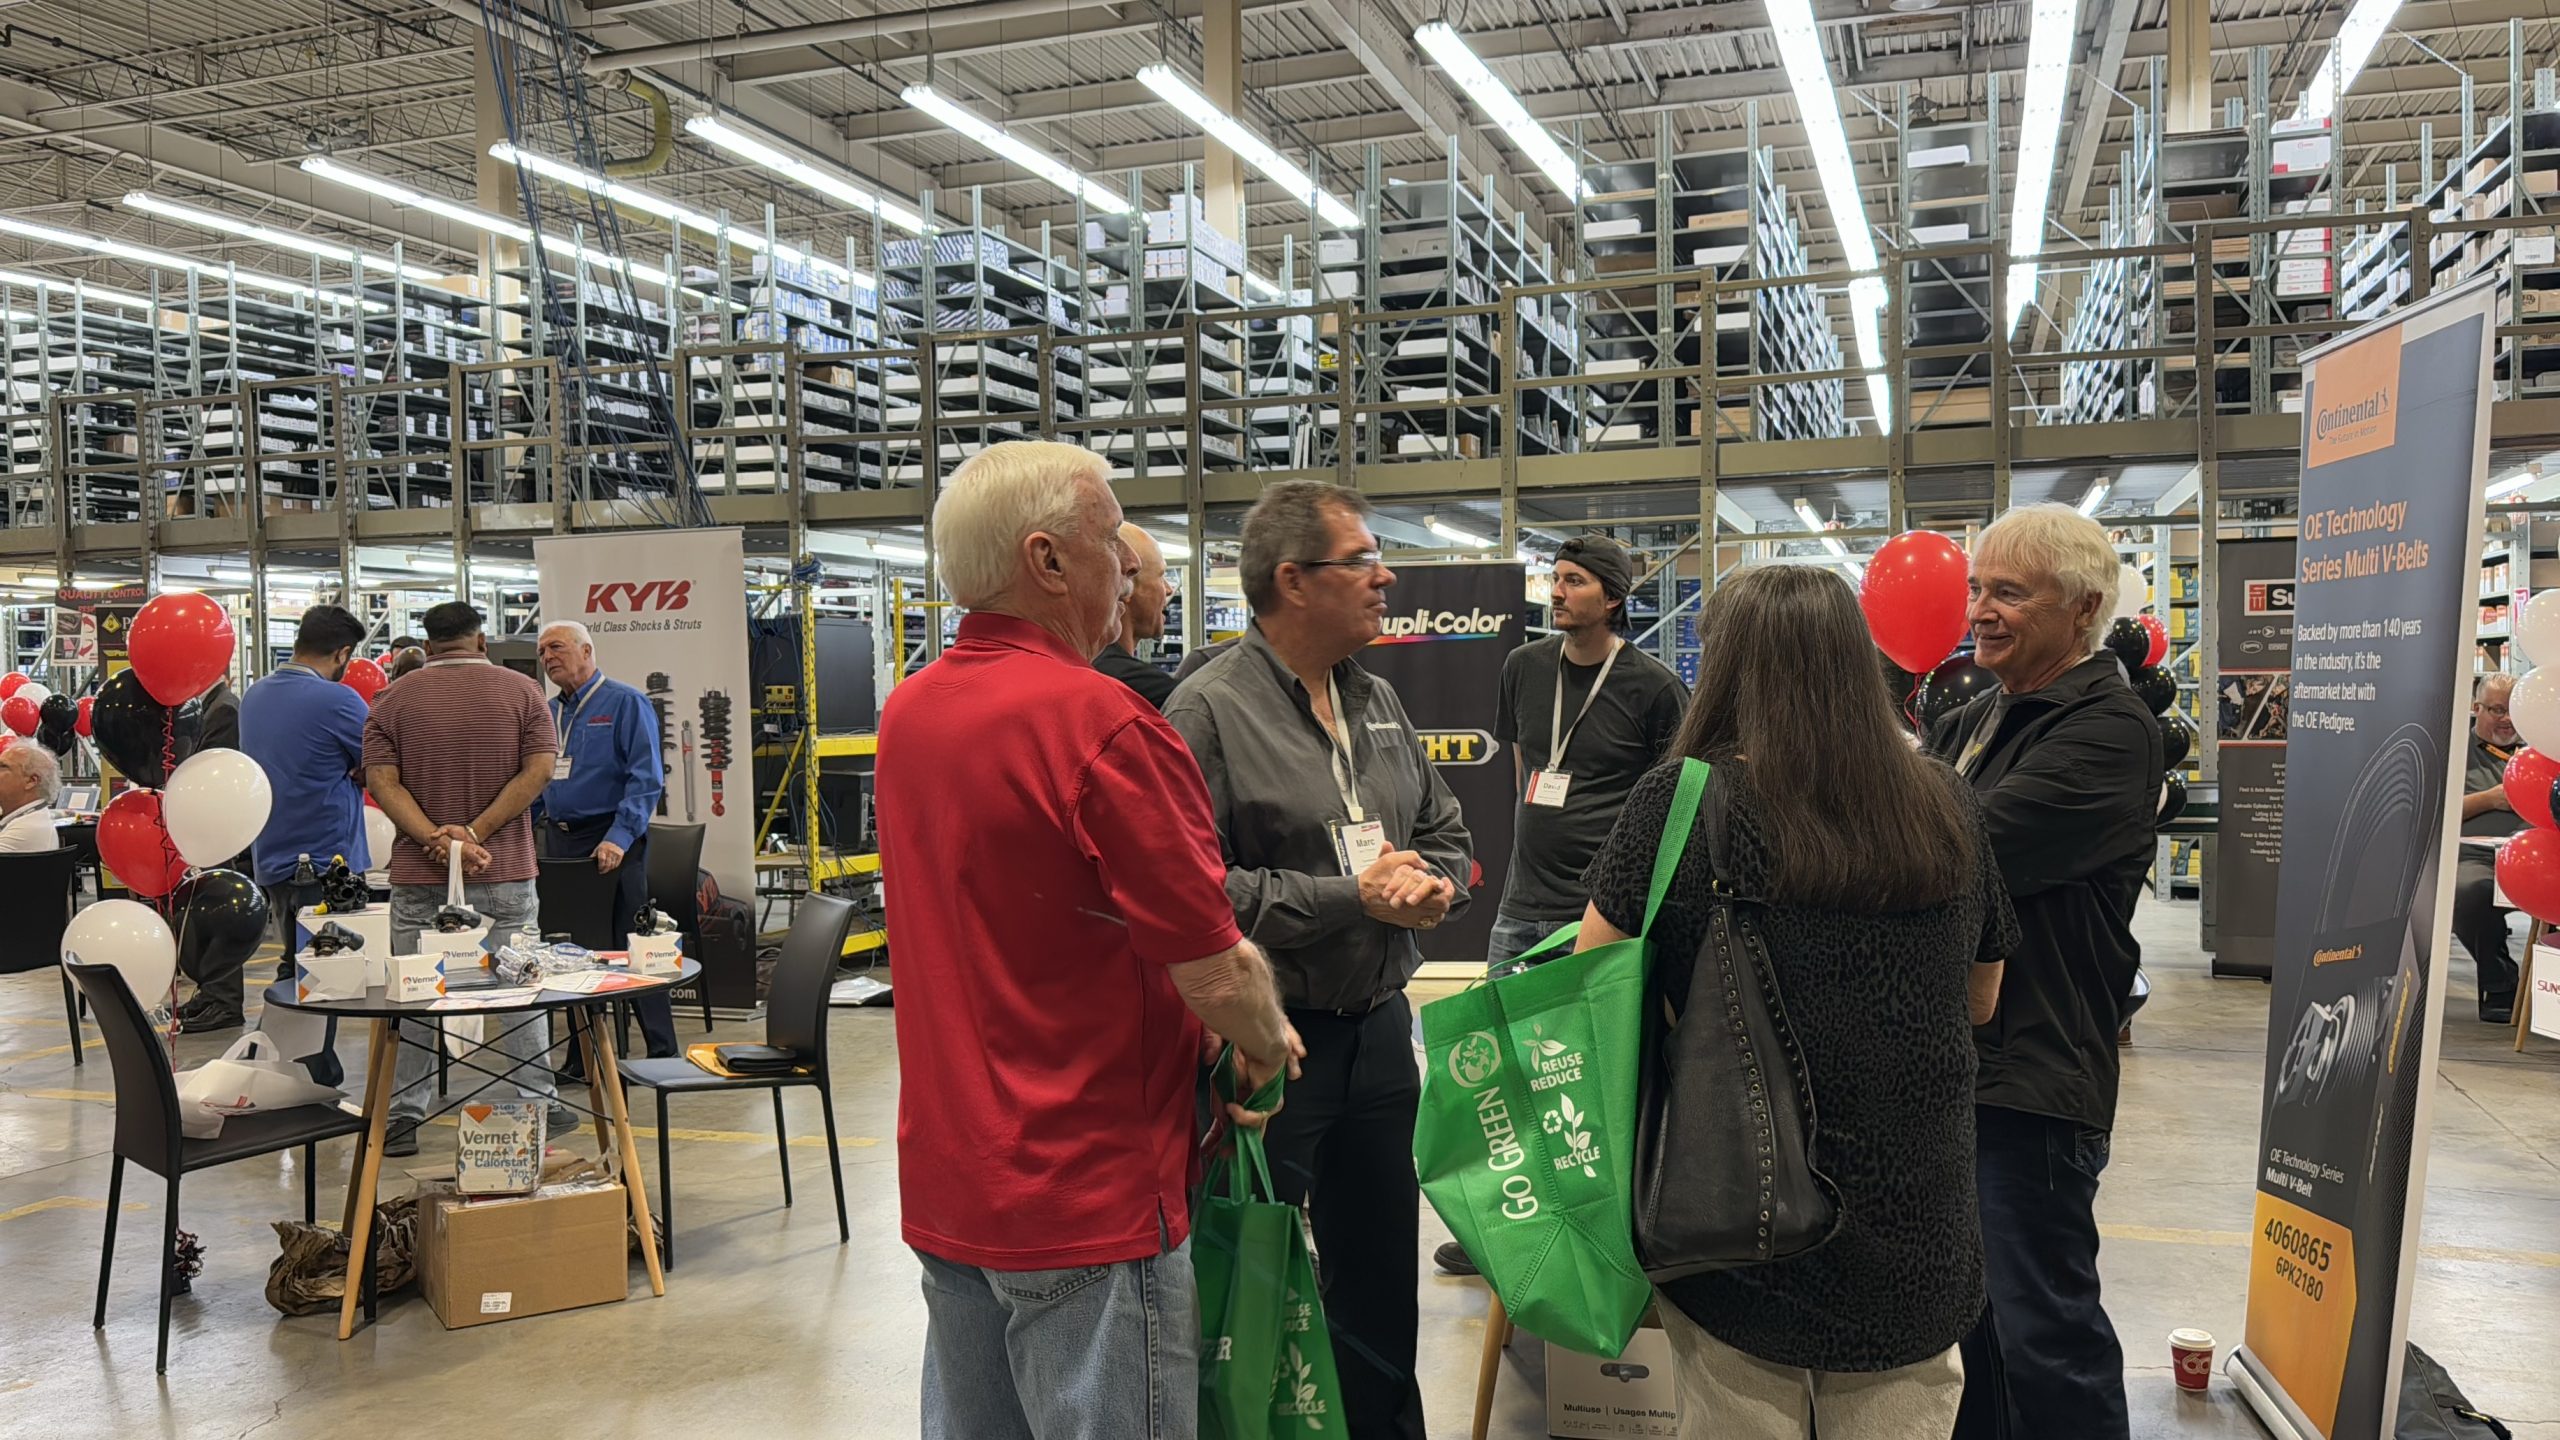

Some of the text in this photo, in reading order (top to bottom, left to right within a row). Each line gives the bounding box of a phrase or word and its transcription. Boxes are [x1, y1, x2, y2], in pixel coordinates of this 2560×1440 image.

[2316, 391, 2379, 440] Continental
[2304, 500, 2407, 540] OE Technology
[2301, 539, 2429, 584] Series Multi V-Belts
[58, 588, 146, 600] QUALITY CONTROL
[585, 580, 692, 613] KYB
[585, 618, 702, 633] orld Class Shocks & Struts
[2297, 617, 2422, 644] Backed by more than 140 years
[2295, 651, 2381, 674] in the industry, it's the
[2293, 681, 2376, 701] aftermarket belt with
[2292, 711, 2355, 734] the OE Pedigree.
[1418, 735, 1478, 760] HT
[1356, 838, 1375, 848] Marc
[451, 950, 478, 959] Vernet
[654, 950, 677, 959] Vernet
[2313, 945, 2356, 967] Continental
[412, 975, 438, 984] Vernet
[1541, 1051, 1584, 1074] REUSE
[1530, 1067, 1583, 1092] REDUCE
[463, 1130, 518, 1145] Vernet
[474, 1157, 528, 1168] Calorstat
[1473, 1086, 1539, 1220] GO GREEN
[1553, 1146, 1601, 1171] RECYCLE
[2270, 1148, 2345, 1184] OE Technology Series
[2265, 1166, 2313, 1198] Multi V-Belt
[2264, 1217, 2333, 1272] 4060865
[2275, 1256, 2324, 1302] 6PK2180
[1563, 1403, 1601, 1413] Multiuse
[1613, 1407, 1646, 1417] Usages
